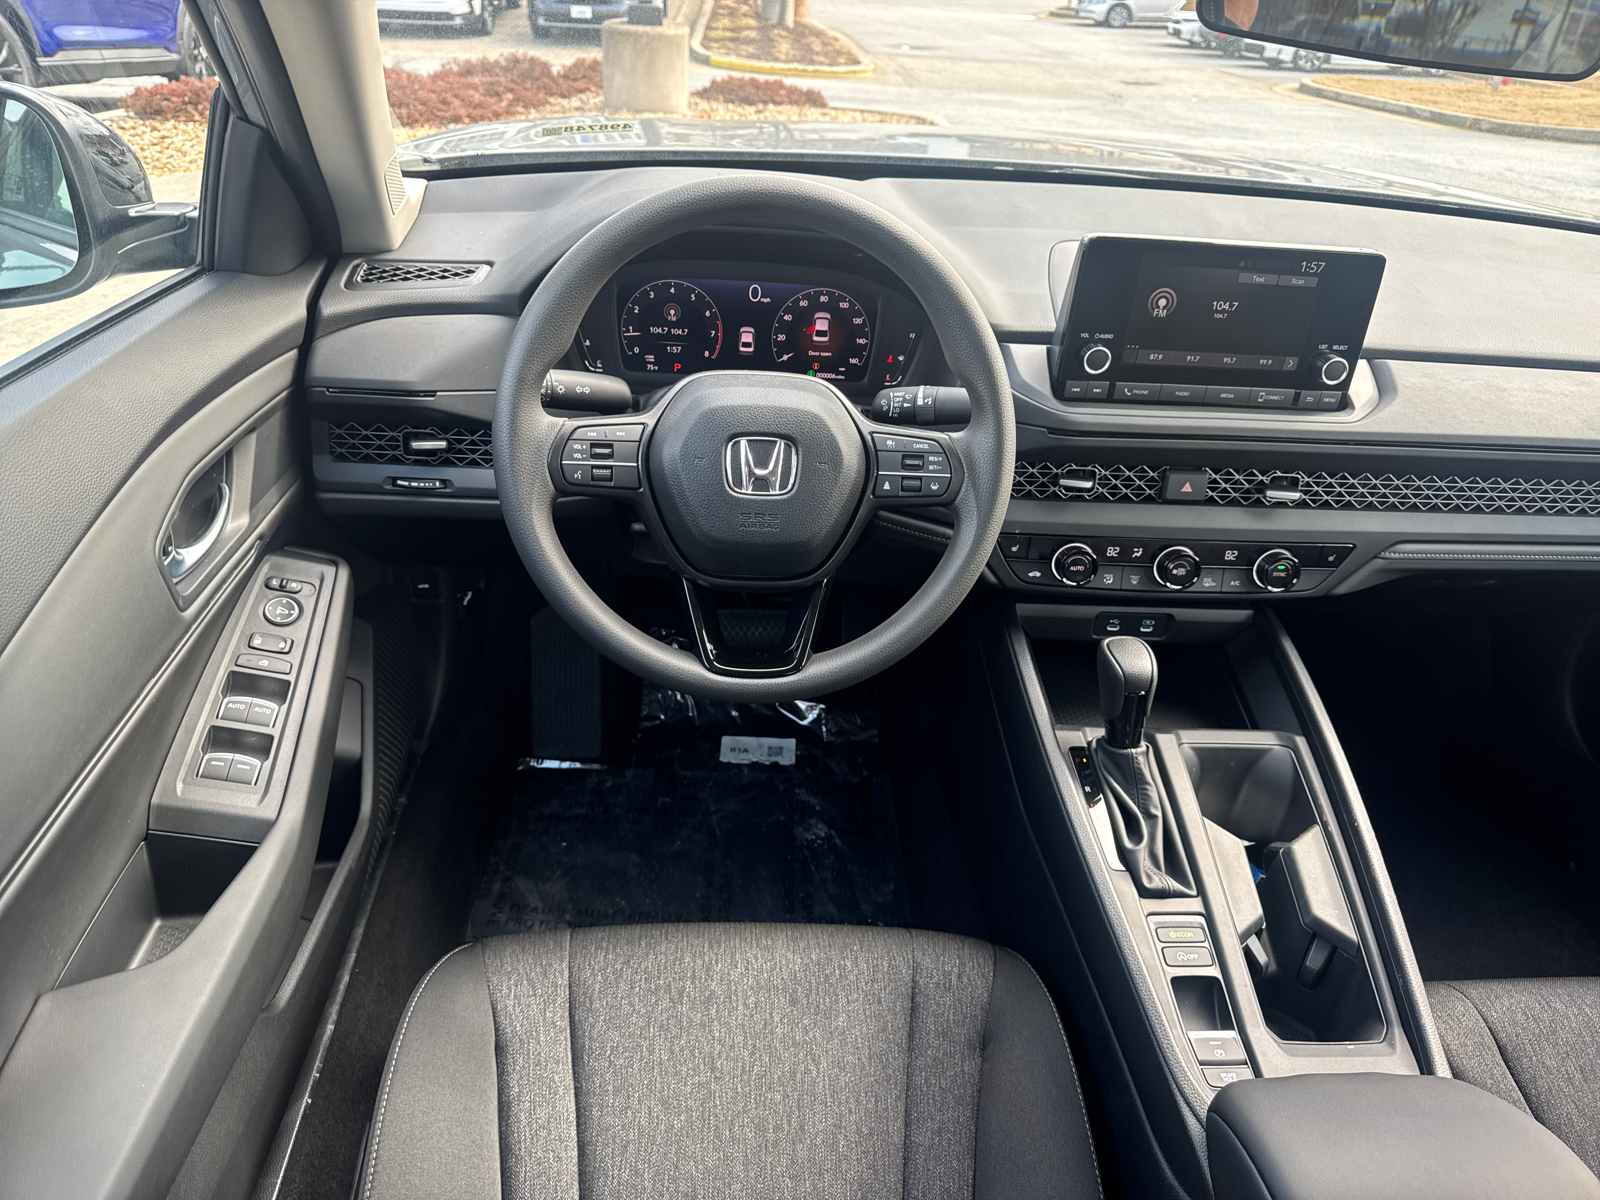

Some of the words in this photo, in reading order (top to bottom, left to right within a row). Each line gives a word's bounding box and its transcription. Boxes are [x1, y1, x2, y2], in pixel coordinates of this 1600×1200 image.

[1301, 261, 1326, 273] 1:57
[1252, 275, 1265, 283] Text
[748, 284, 761, 302] 0
[1212, 300, 1239, 311] 104.7
[1153, 308, 1167, 318] FM
[649, 326, 668, 334] 104.7
[674, 362, 681, 372] P
[739, 522, 780, 530] AIRBAG
[1106, 546, 1120, 557] 82
[1224, 550, 1238, 560] 82
[227, 702, 246, 710] AUTO
[1084, 785, 1092, 793] R
